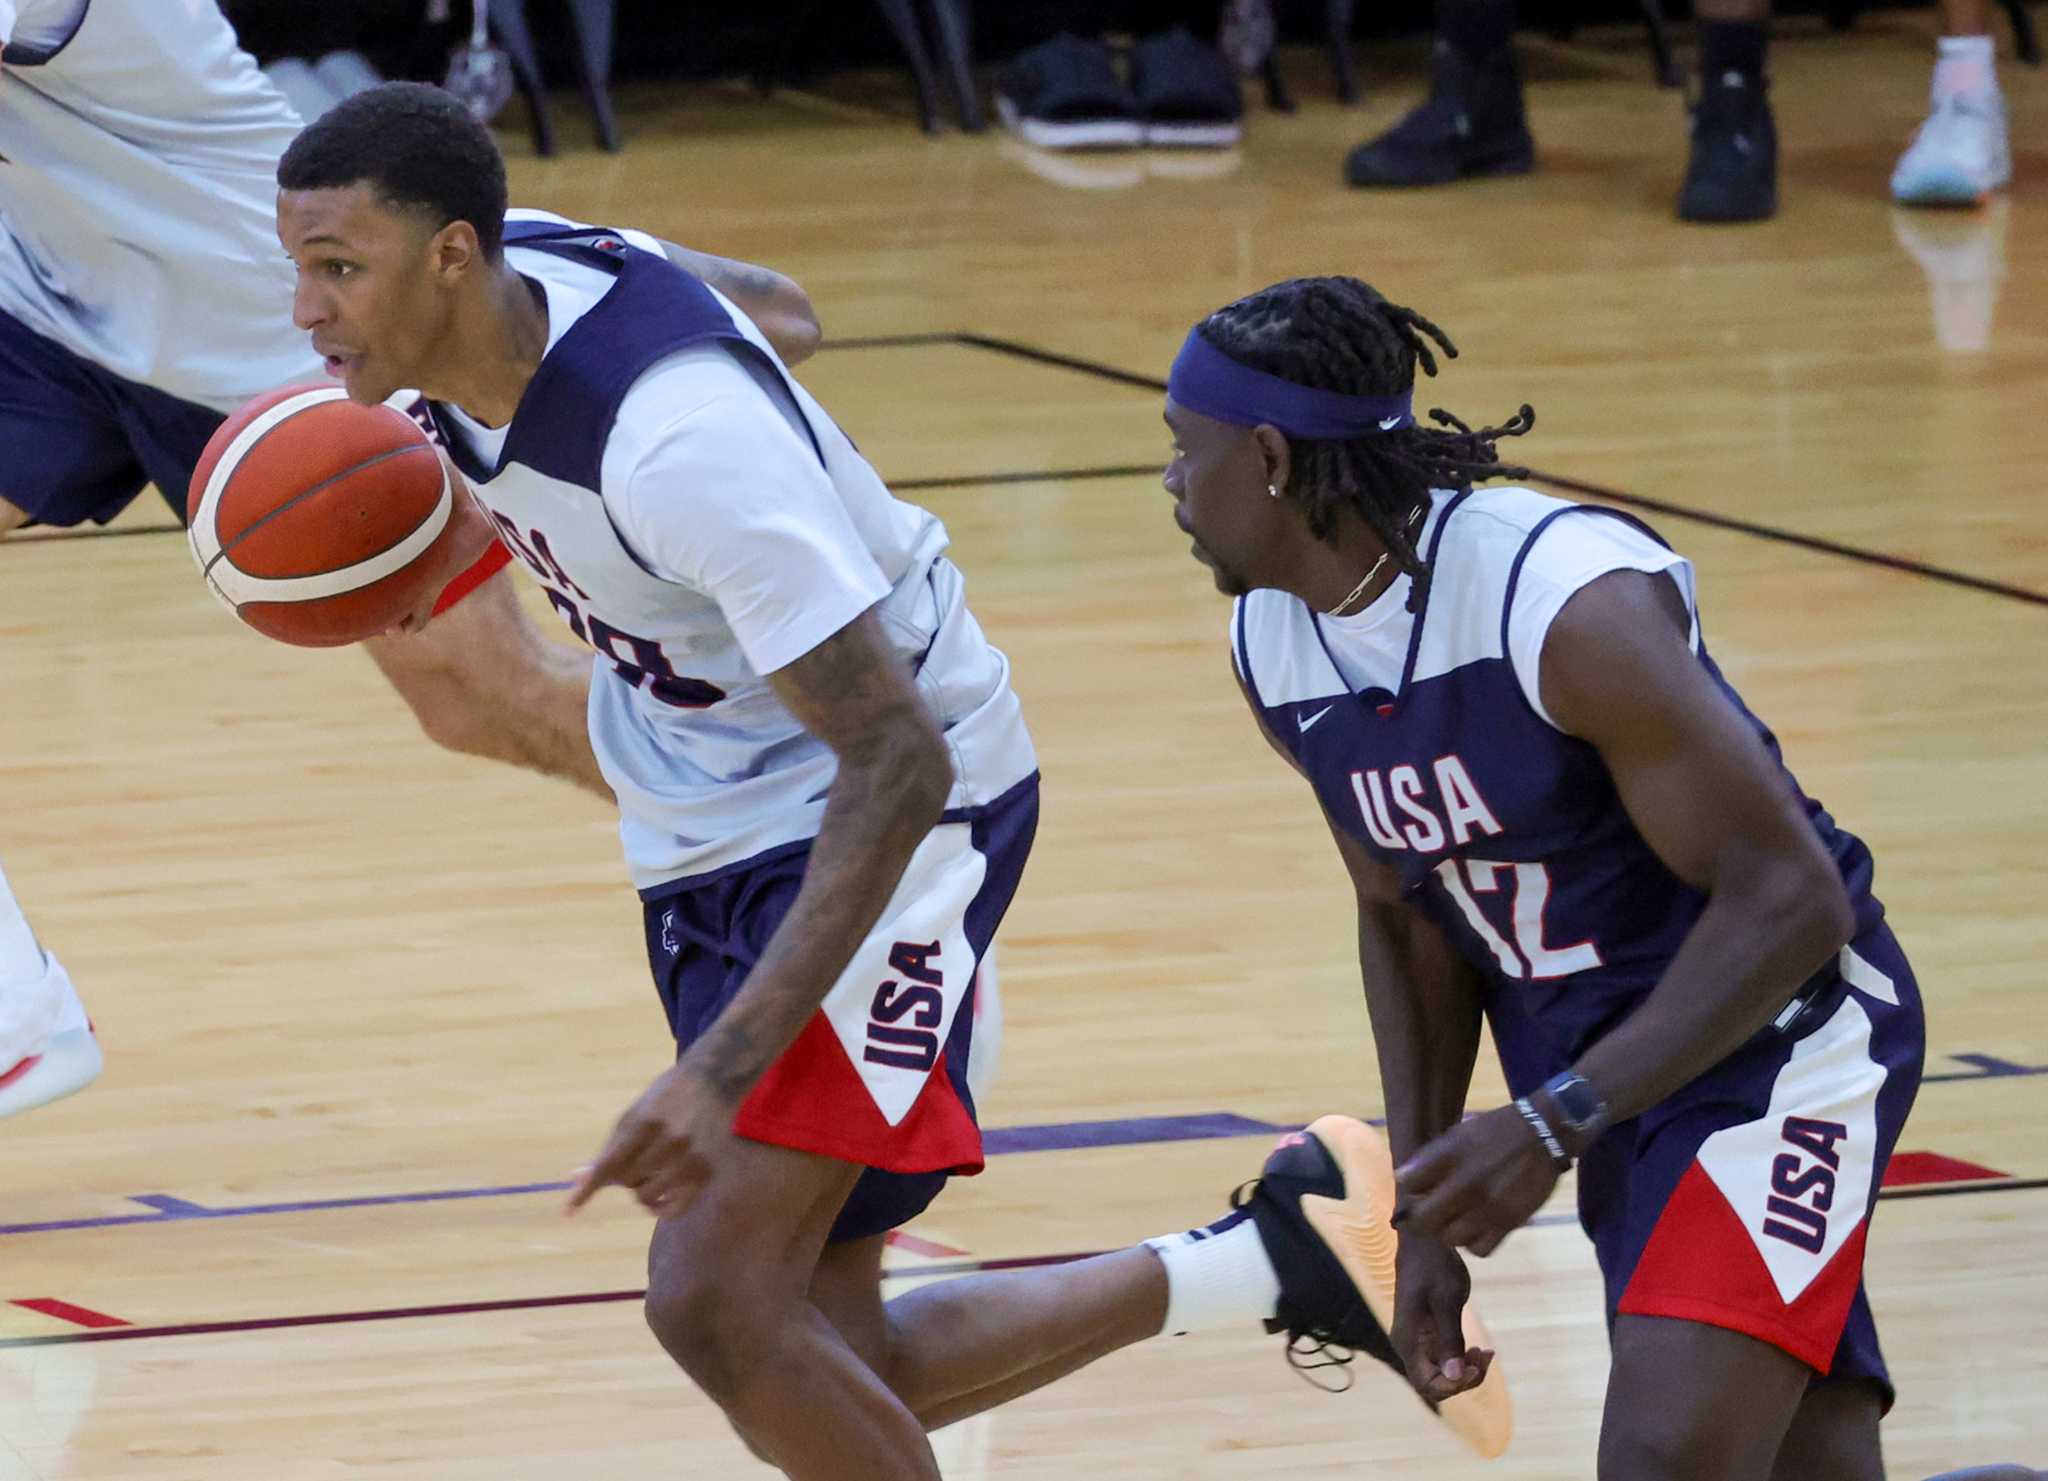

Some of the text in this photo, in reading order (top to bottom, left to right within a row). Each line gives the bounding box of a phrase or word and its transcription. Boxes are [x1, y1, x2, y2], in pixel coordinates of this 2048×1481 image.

[1350, 754, 1503, 853] USA
[1432, 856, 1605, 981] 12
[863, 939, 944, 1073] USA
[1762, 1116, 1848, 1255] USA
